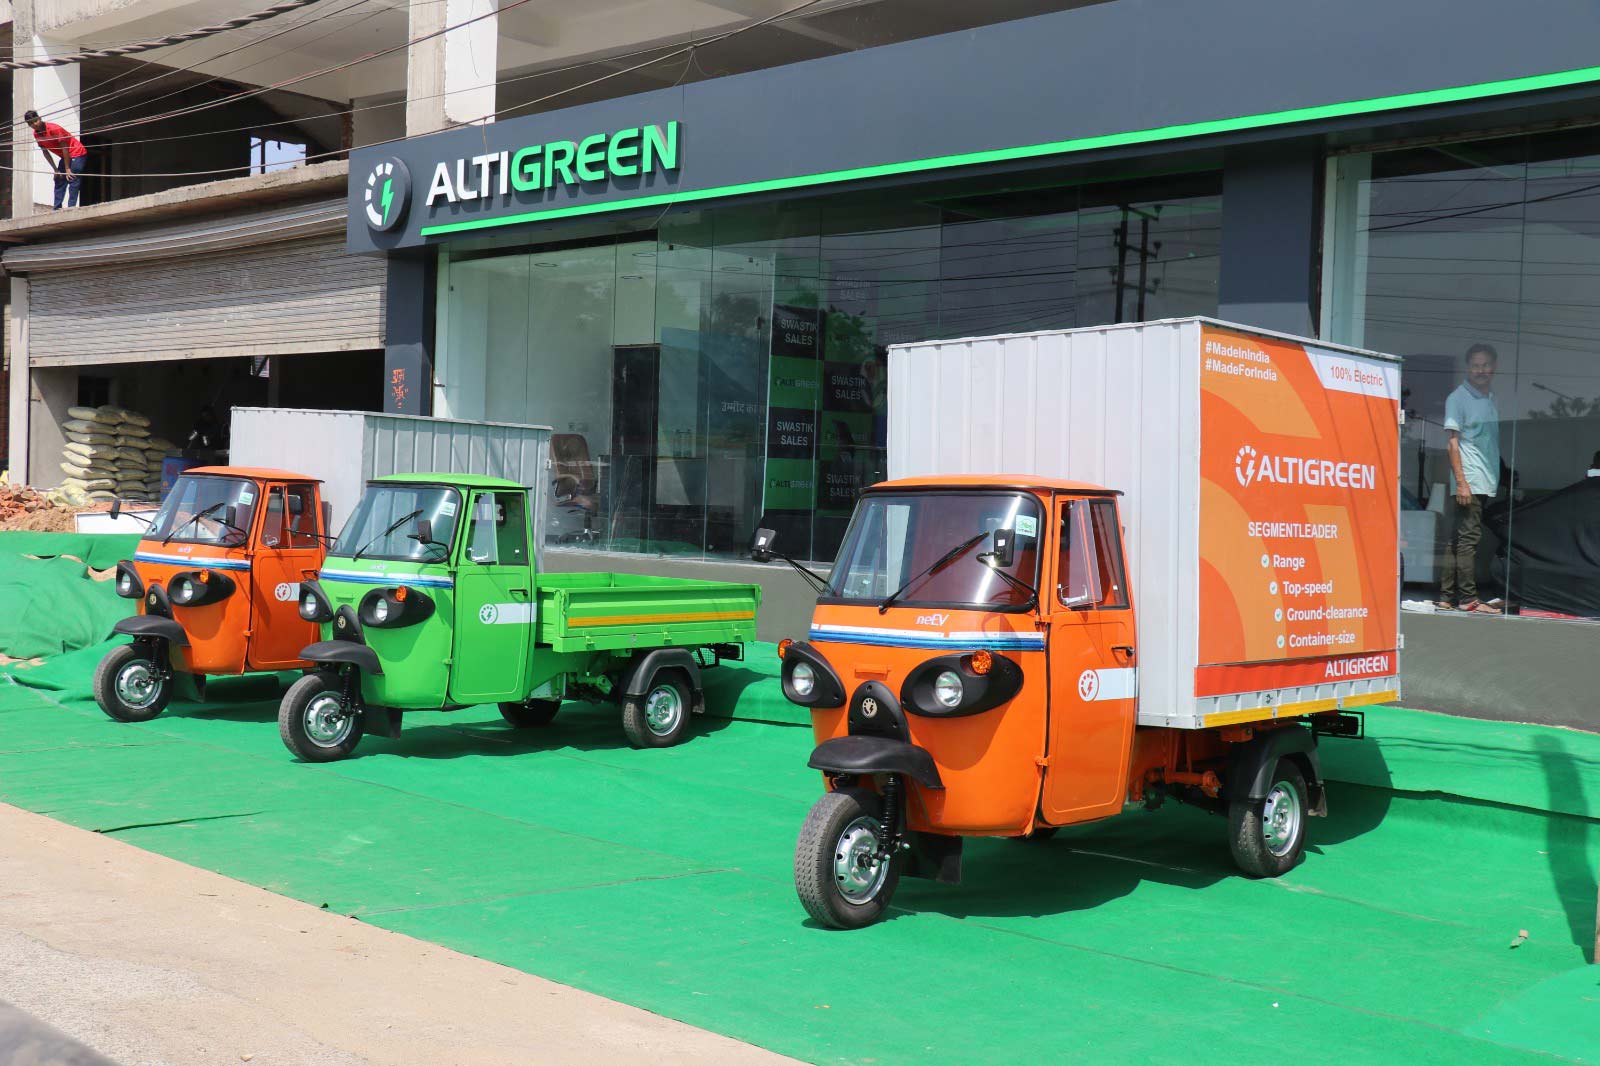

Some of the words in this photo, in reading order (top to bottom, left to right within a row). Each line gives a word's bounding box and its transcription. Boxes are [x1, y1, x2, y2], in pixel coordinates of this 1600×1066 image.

[426, 121, 678, 206] ALTIGREEN
[785, 332, 813, 346] SALES
[1206, 341, 1270, 364] #MadeInIndia
[1205, 358, 1277, 381] #MadeForIndia
[1330, 366, 1352, 381] 100%
[1354, 369, 1383, 386] Electric
[831, 375, 866, 388] SWASTIK
[835, 389, 861, 400] SALES
[776, 421, 813, 433] SWASTIK
[780, 434, 808, 446] SALES
[1257, 455, 1376, 489] ALTIGREEN
[829, 487, 856, 497] SALES
[1273, 554, 1305, 571] Range
[1283, 580, 1333, 597] Top-speed
[1287, 606, 1368, 621] Ground-clearance
[1289, 630, 1355, 648] Container-size
[1325, 656, 1389, 678] ALTIGREEN
